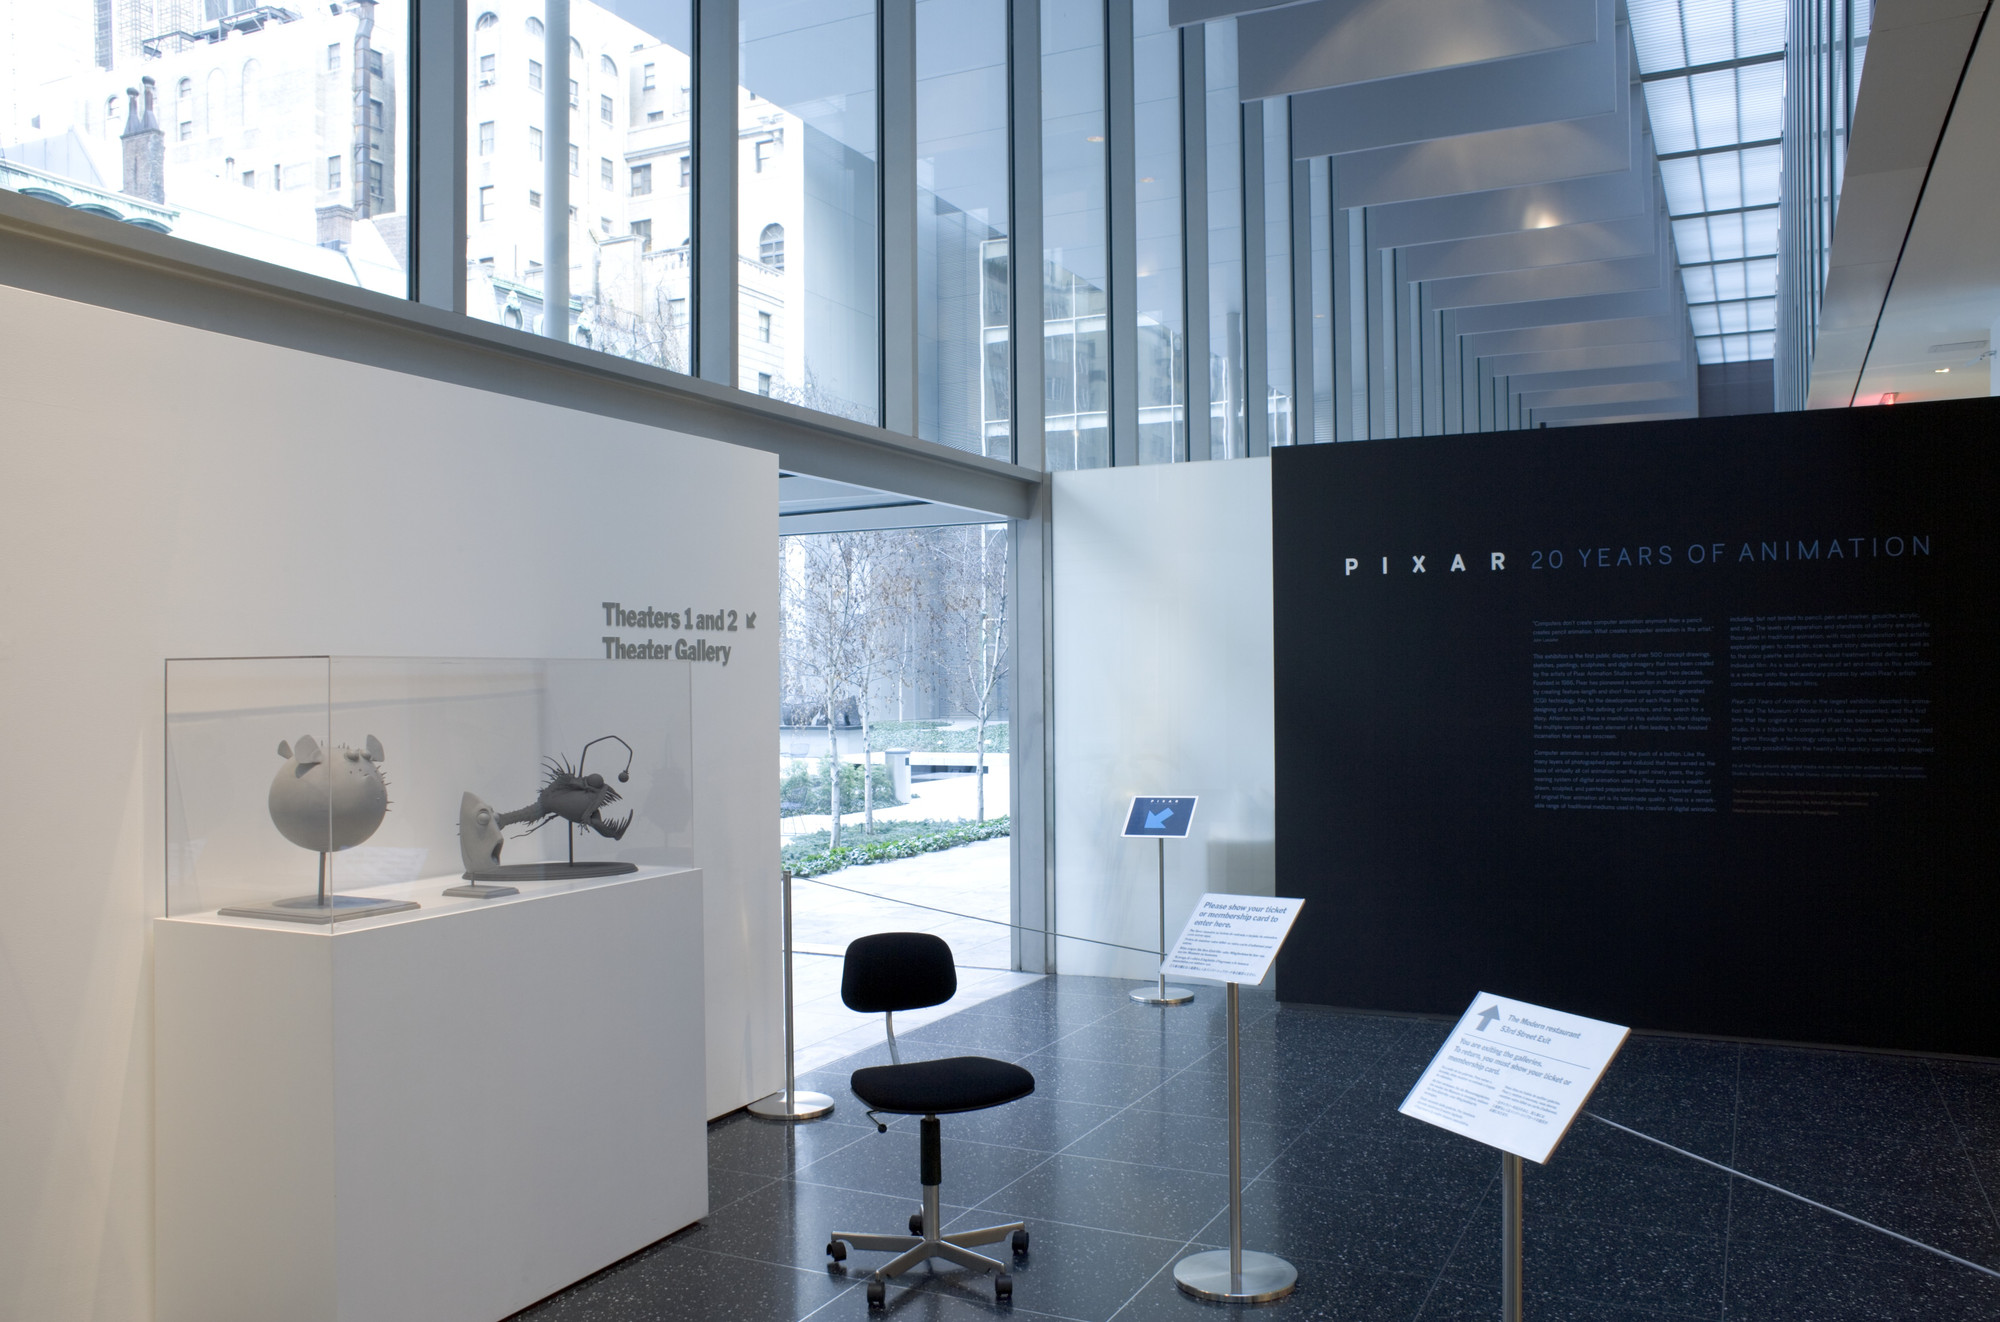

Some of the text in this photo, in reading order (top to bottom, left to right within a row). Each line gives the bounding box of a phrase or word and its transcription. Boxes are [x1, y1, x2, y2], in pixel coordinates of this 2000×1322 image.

[1345, 535, 1930, 576] PIXAR 20 YEARS OF ANIMATION
[602, 602, 737, 631] Theaters 1 and 2
[602, 637, 731, 666] Theater Gallery
[1204, 902, 1227, 910] Please
[1208, 911, 1252, 921] membership
[1500, 1026, 1551, 1044] 53rd Street Exit
[1508, 1015, 1581, 1039] The Modern restaurant
[1448, 1055, 1500, 1075] membership card.
[1460, 1038, 1471, 1046] You
[1482, 1043, 1502, 1056] exiting
[1502, 1049, 1514, 1058] the
[1514, 1054, 1542, 1067] galleries.
[1462, 1049, 1481, 1059] return,
[1482, 1054, 1494, 1063] you
[1494, 1058, 1510, 1068] must
[1511, 1062, 1527, 1072] show
[1527, 1069, 1543, 1077] your
[1544, 1071, 1563, 1083] ticket
